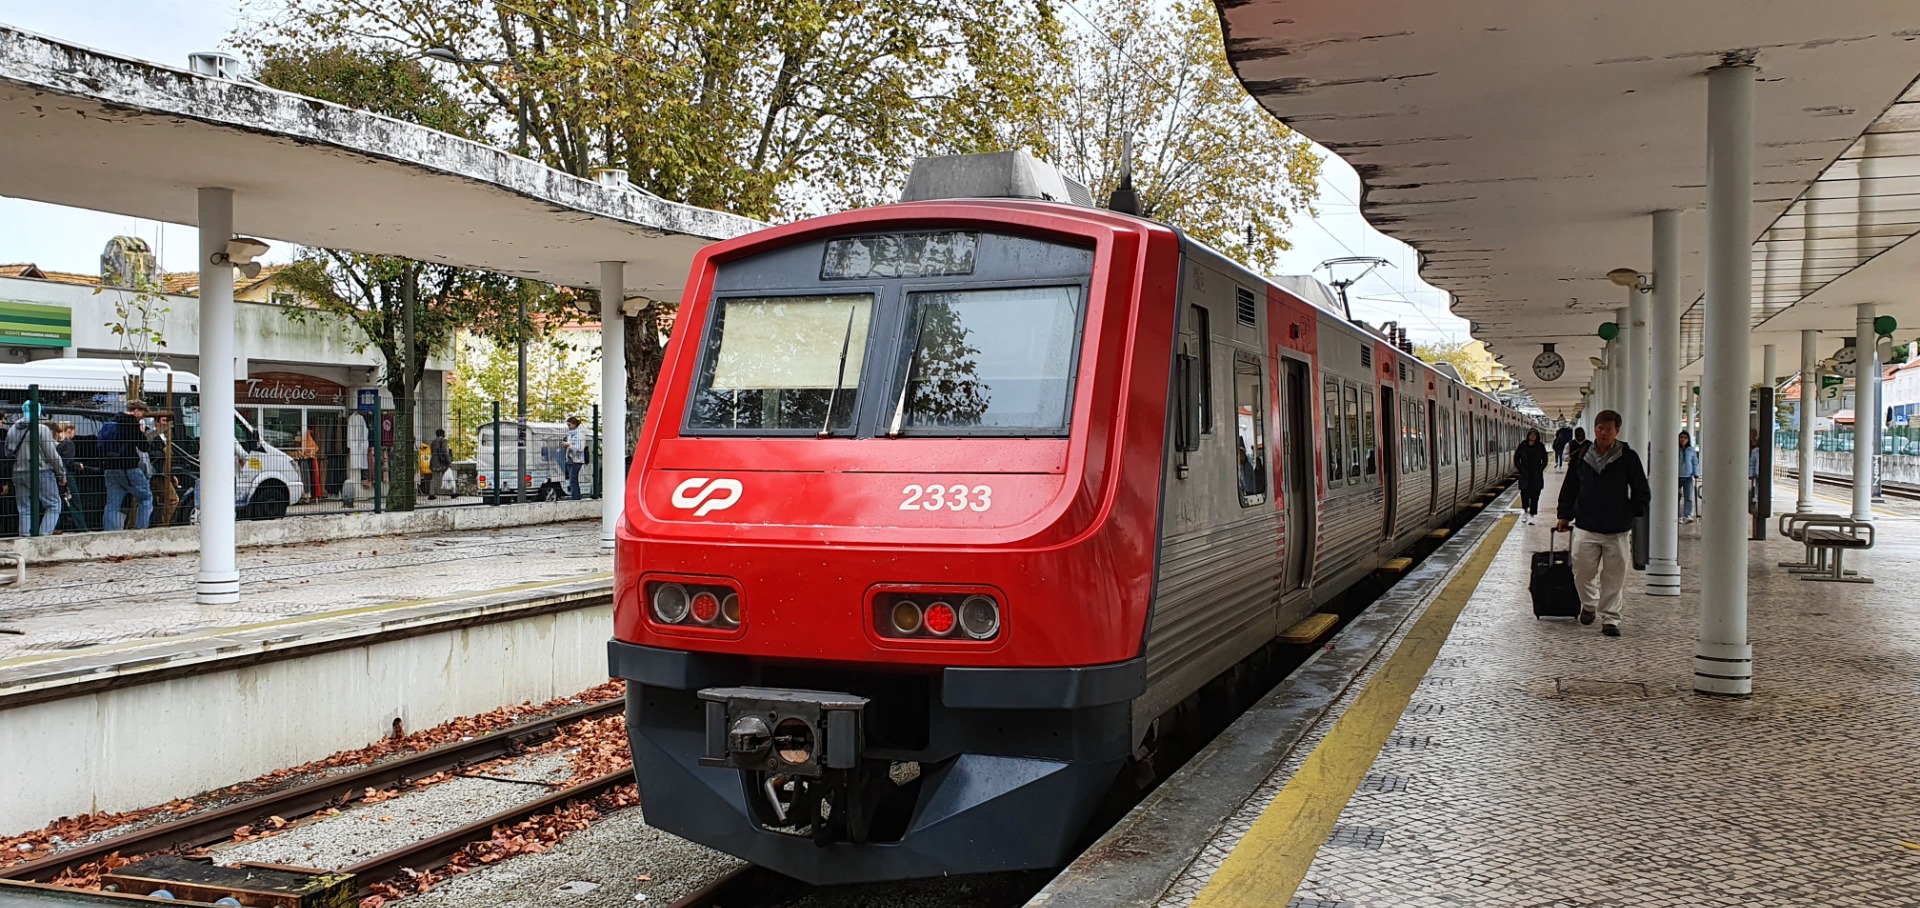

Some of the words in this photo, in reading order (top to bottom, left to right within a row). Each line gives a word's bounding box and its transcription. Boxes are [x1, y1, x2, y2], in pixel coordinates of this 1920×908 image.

[245, 378, 317, 404] Tradições
[1827, 387, 1837, 398] 3
[671, 477, 743, 516] CP
[899, 484, 992, 512] 2333
